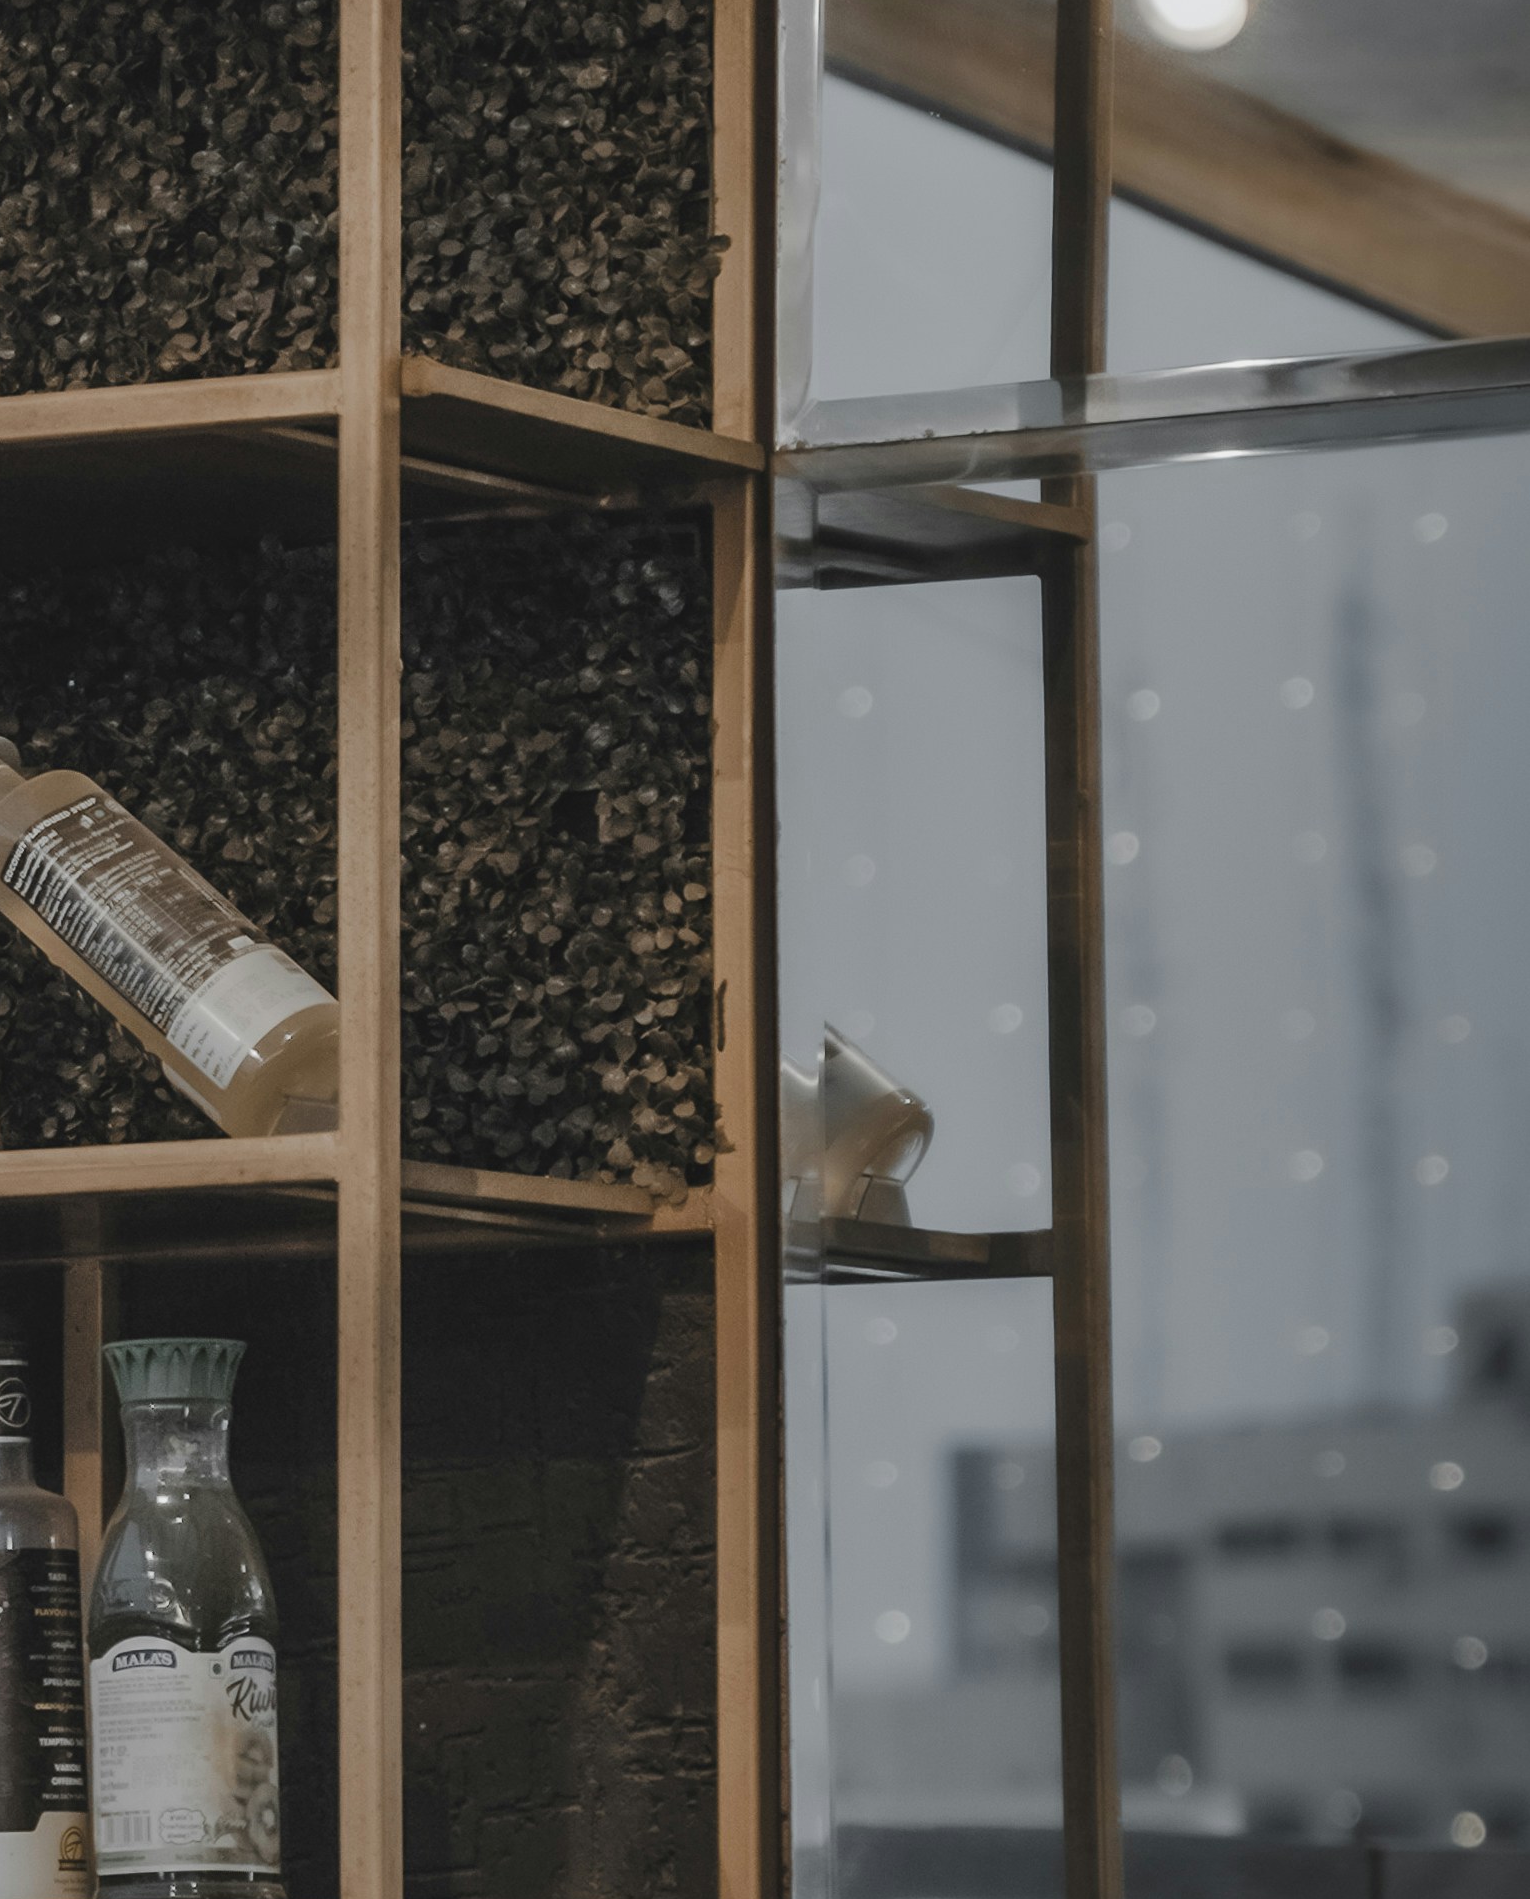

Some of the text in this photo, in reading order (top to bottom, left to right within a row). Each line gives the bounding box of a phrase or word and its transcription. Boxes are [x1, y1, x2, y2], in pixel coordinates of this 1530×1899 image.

[25, 809, 70, 846] FLAVOURED
[68, 796, 97, 816] SYRUP
[115, 1653, 173, 1670] MALA'S
